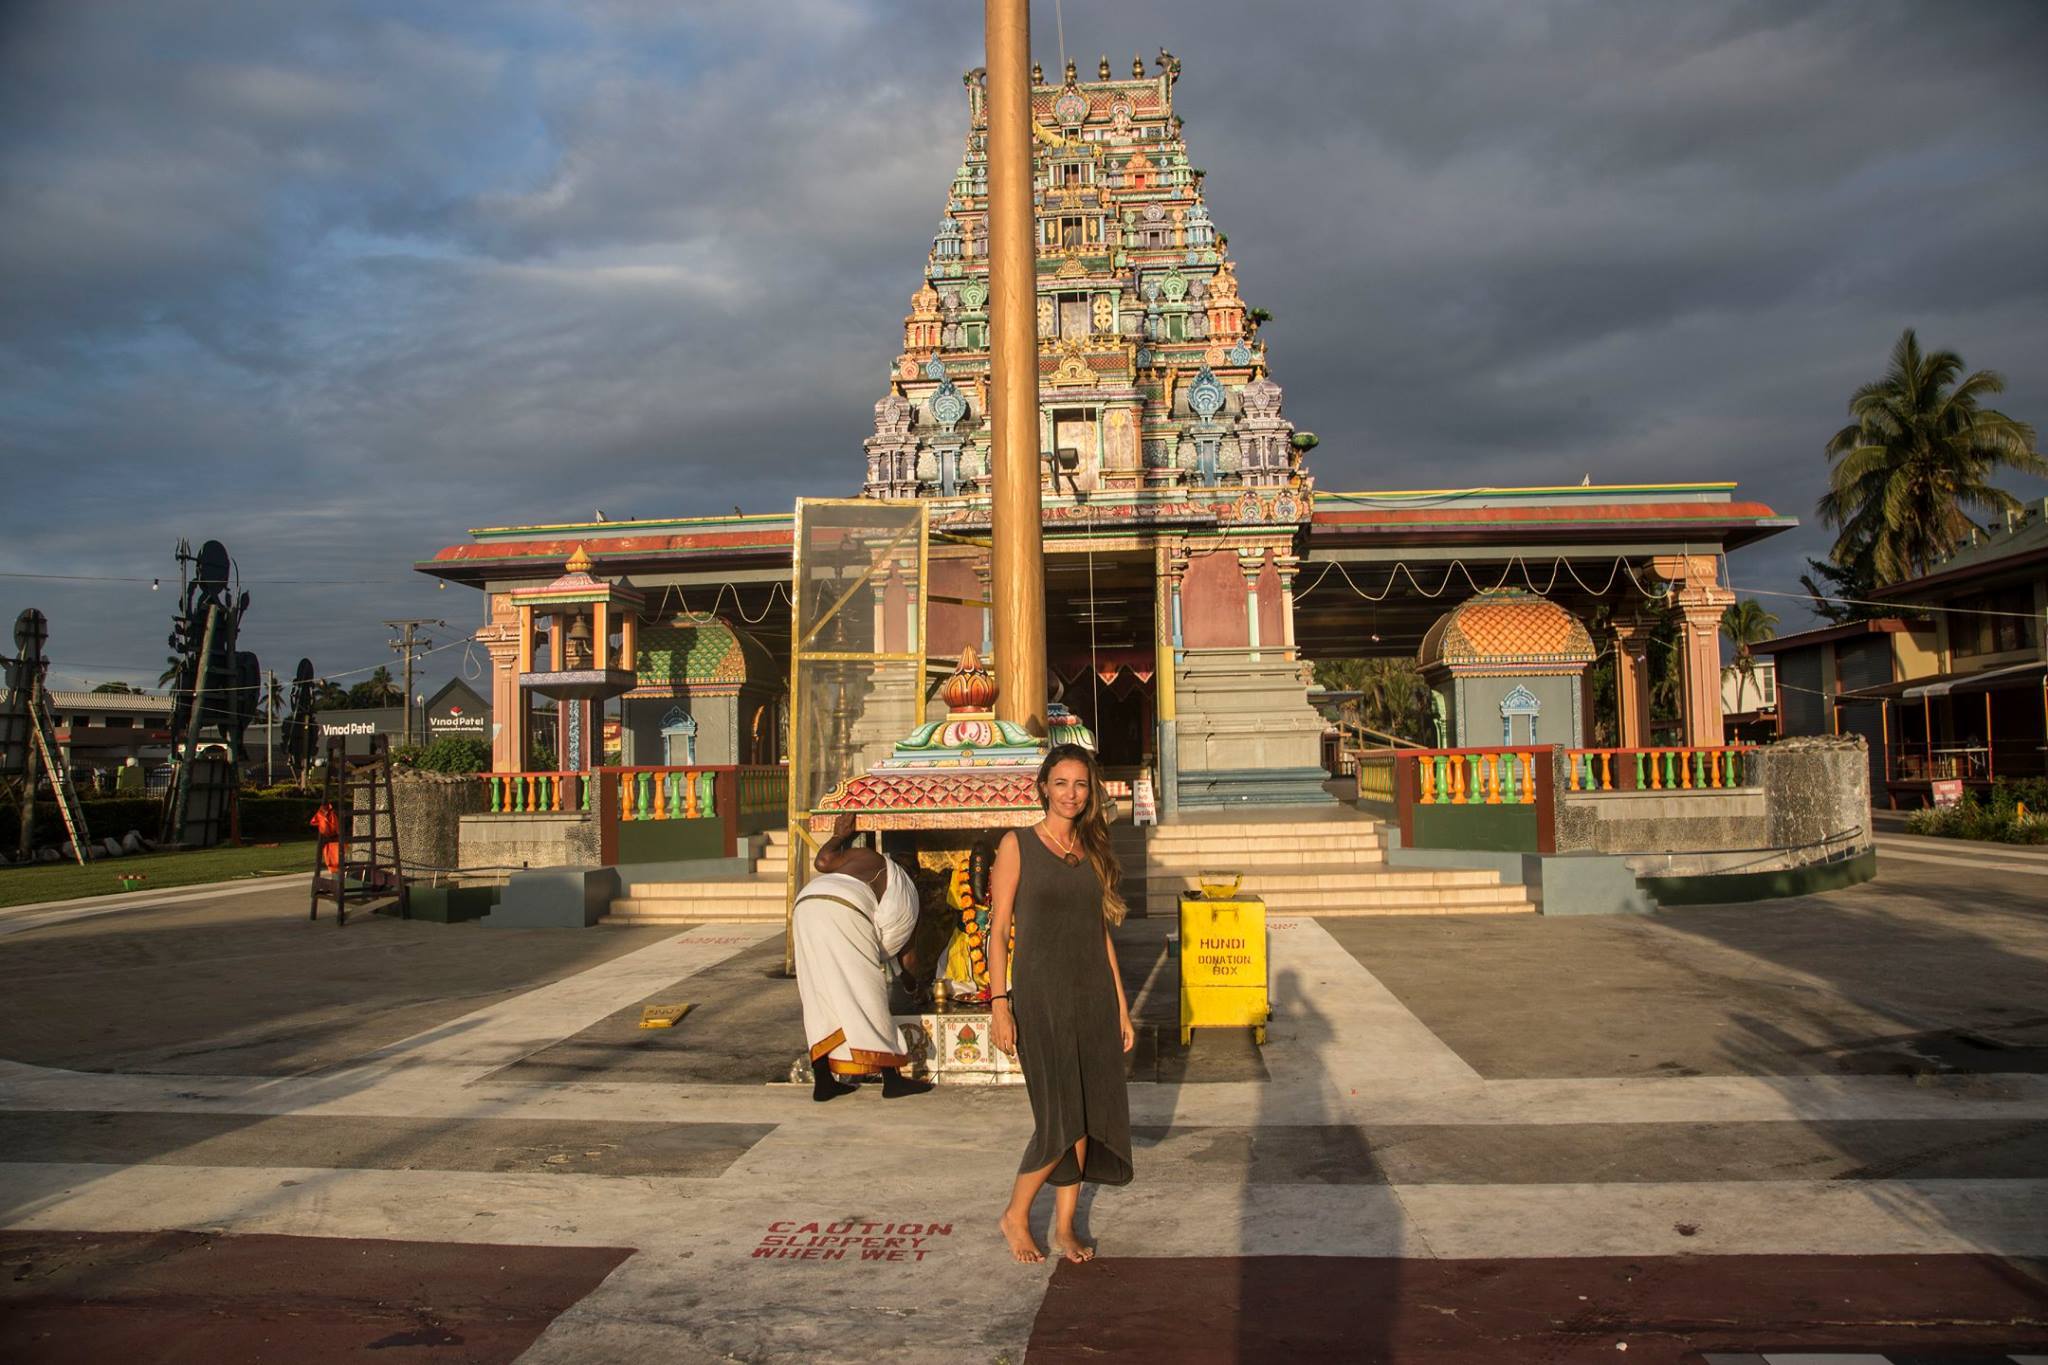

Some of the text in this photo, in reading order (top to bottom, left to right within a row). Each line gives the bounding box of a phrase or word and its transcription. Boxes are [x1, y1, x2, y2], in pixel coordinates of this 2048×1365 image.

[430, 717, 484, 726] Vinod Patel
[323, 722, 375, 736] Vinod Patel
[1200, 938, 1246, 950] HUNDI
[1198, 955, 1251, 965] DONATION
[1212, 966, 1238, 976] BOX
[767, 1221, 954, 1236] CAUTION
[759, 1235, 927, 1249] SLIPPERY
[751, 1247, 932, 1262] WHEN WET
